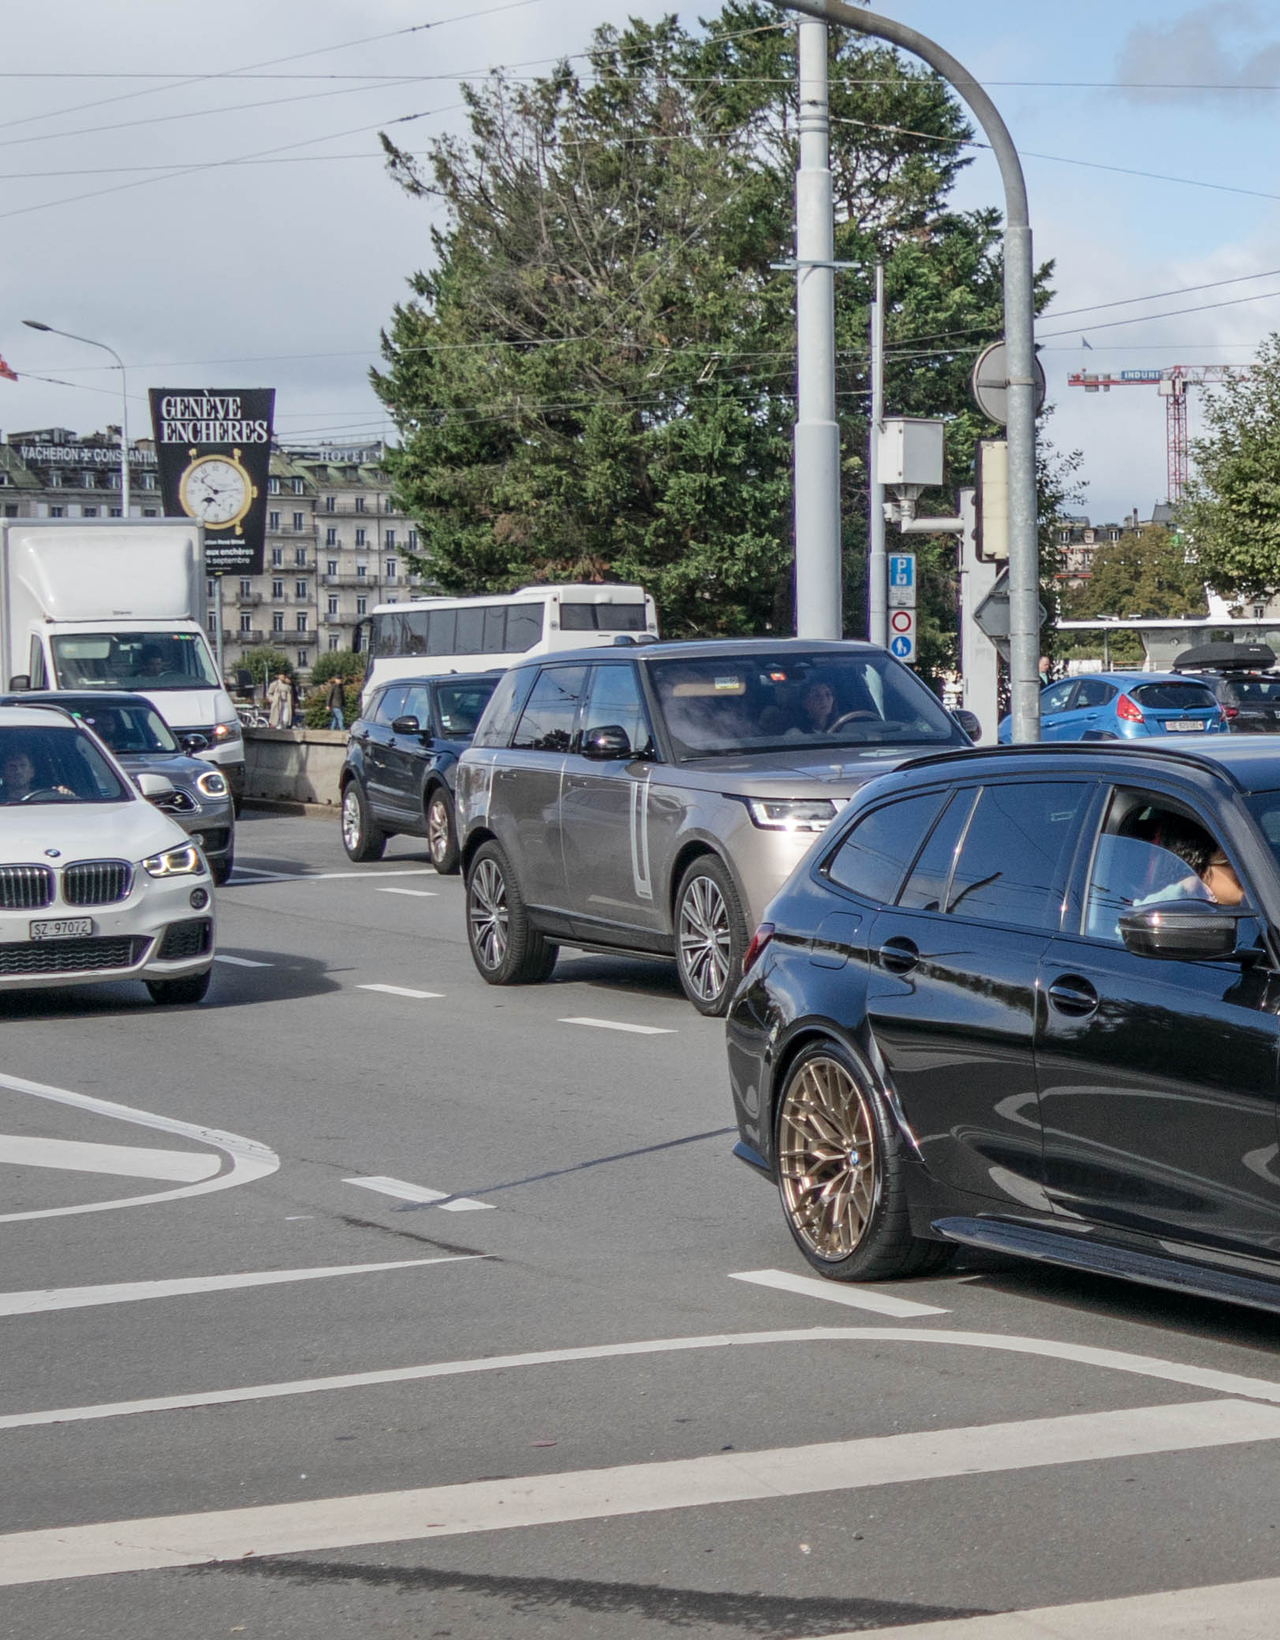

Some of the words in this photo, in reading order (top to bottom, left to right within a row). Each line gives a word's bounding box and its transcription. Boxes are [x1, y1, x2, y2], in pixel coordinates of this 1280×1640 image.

[1124, 371, 1159, 379] INDUNI
[162, 389, 241, 419] GENÈVE
[161, 413, 268, 443] ENCHÈRES
[21, 446, 79, 461] VACHERON
[93, 448, 159, 463] CONSANTIN
[320, 450, 370, 462] HOTEL
[898, 559, 907, 572] P
